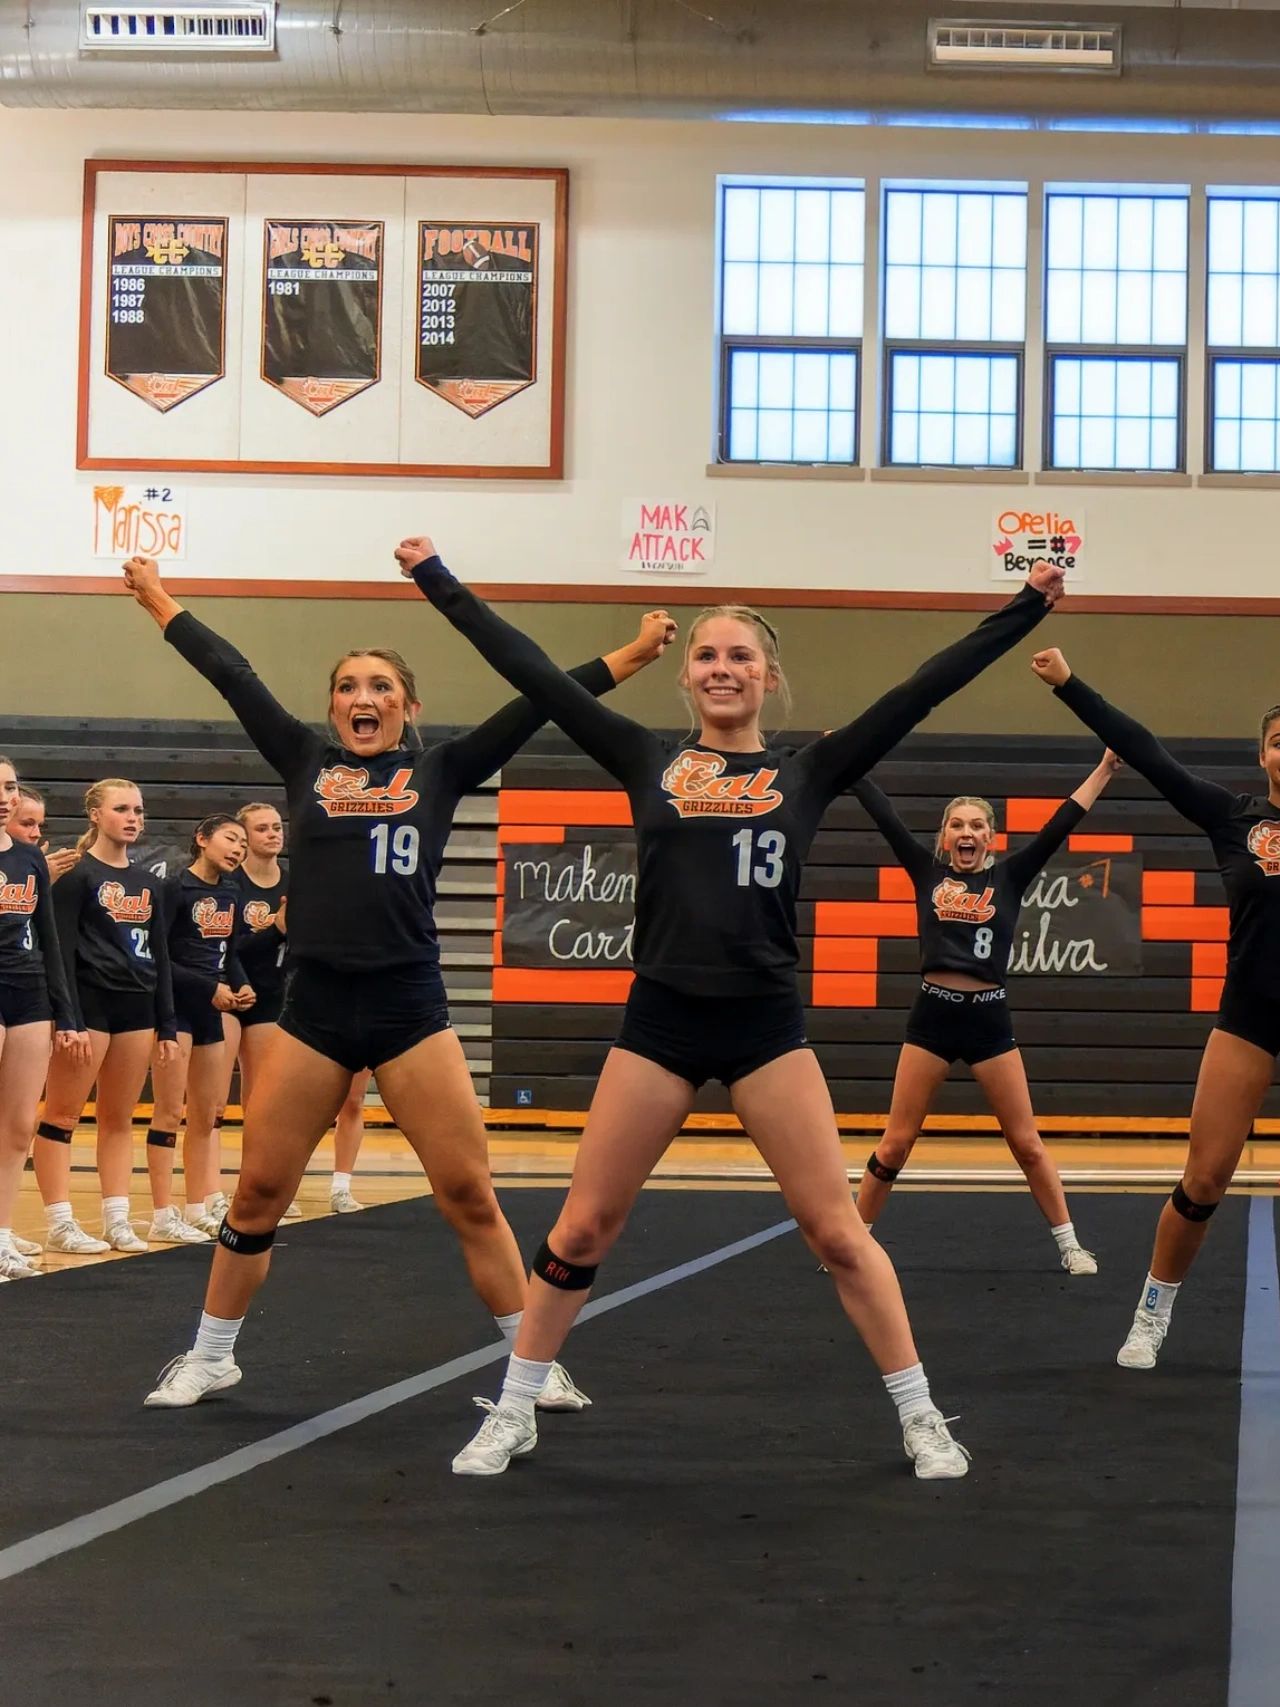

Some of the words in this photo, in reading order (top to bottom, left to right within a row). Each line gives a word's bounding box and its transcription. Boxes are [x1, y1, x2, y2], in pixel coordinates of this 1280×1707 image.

[424, 229, 531, 263] FOOTBALL
[114, 266, 155, 275] LEAGUE
[158, 267, 219, 276] CHAMPIONS
[269, 270, 311, 279] LEAGUE
[314, 271, 376, 280] CHAMPIONS
[424, 271, 465, 280] LEAGUE
[469, 273, 530, 281] CHAMPIONS
[113, 278, 145, 292] 1986
[268, 281, 300, 295] 1981
[422, 284, 456, 298] 2007
[112, 294, 145, 308] 1987
[422, 300, 456, 313] 2012
[112, 310, 145, 324] 1988
[421, 315, 455, 329] 2013
[421, 331, 455, 346] 2014
[143, 487, 173, 502] #2
[93, 486, 182, 556] Marissa
[641, 504, 688, 531] MAK
[998, 511, 1076, 534] Ofelia
[629, 532, 706, 561] ATTACK
[1050, 536, 1082, 555] #7
[665, 752, 783, 801] Cal
[330, 801, 395, 814] GRIZZLIES
[683, 800, 754, 814] GRIZZLIES
[369, 823, 420, 876] 19
[732, 828, 786, 888] 13
[974, 927, 993, 959] 8
[928, 986, 965, 1003] PRO
[972, 988, 1007, 1003] NIKE
